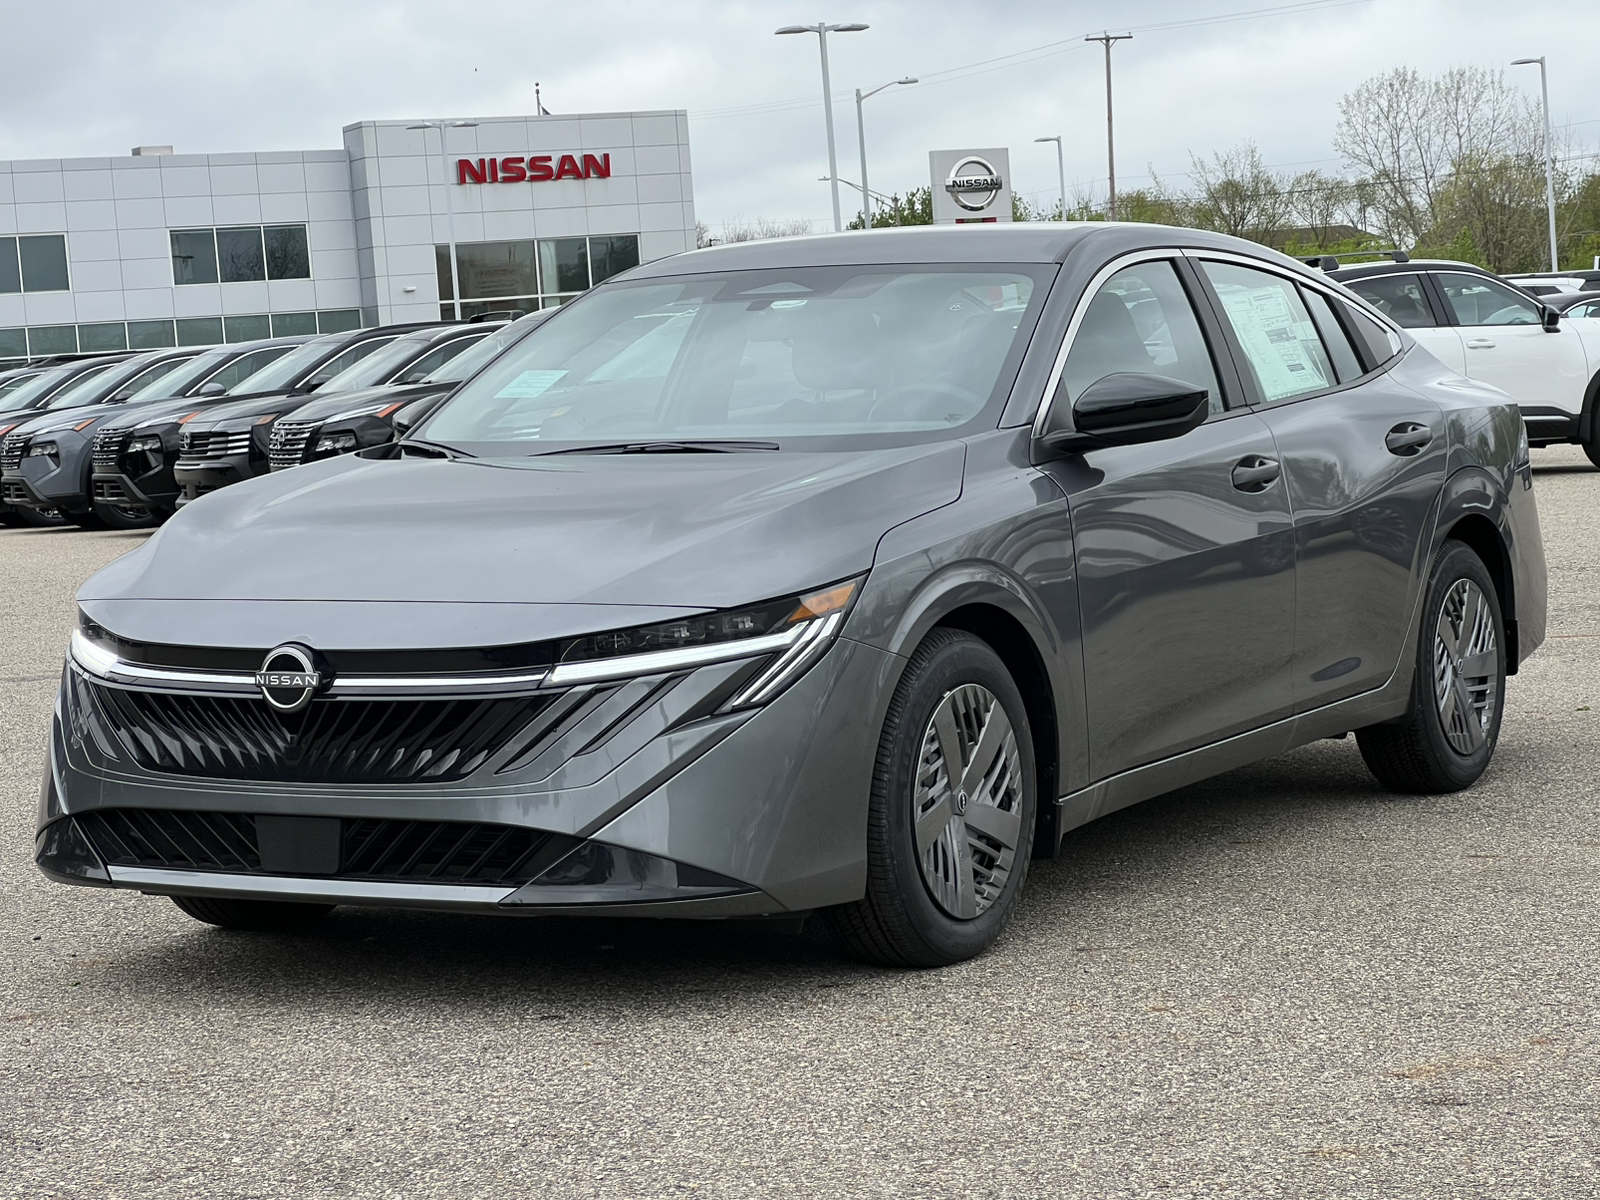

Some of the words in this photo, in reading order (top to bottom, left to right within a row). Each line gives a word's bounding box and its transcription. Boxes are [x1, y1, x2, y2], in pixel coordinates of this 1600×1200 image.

[457, 153, 611, 185] NISSAN
[952, 178, 998, 188] NISSAN
[256, 674, 316, 686] NISSAN
